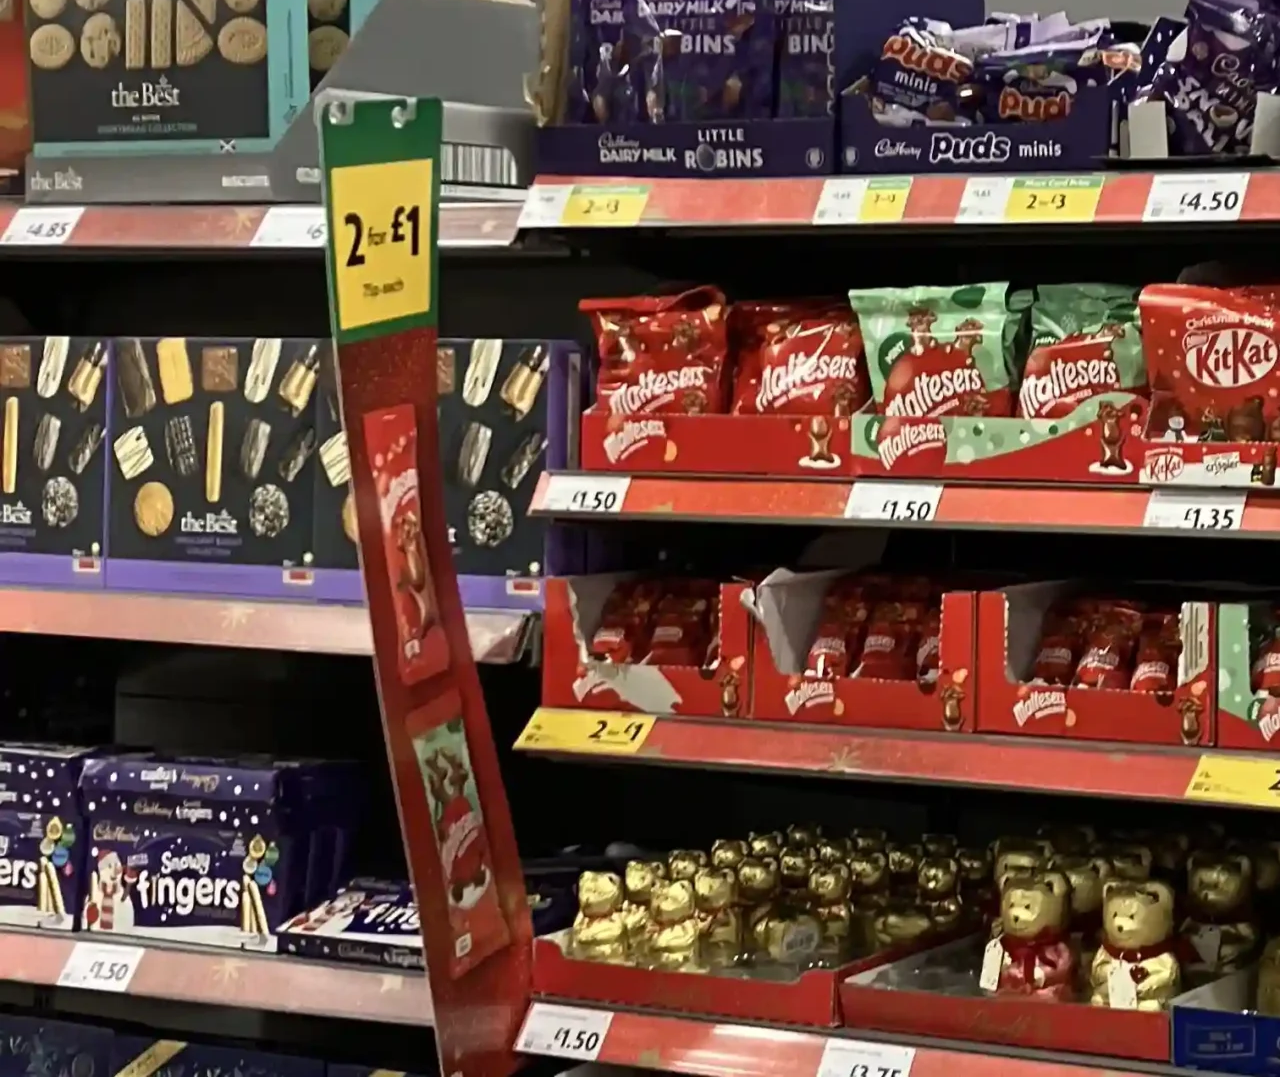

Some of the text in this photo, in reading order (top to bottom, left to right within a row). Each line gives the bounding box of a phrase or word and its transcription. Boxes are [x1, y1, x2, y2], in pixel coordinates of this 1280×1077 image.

[686, 0, 726, 14] MILK
[882, 35, 974, 82] Puds
[894, 70, 938, 93] minis
[111, 82, 180, 108] the Best
[599, 132, 641, 152] Cadbury
[698, 128, 745, 142] LITTLE
[600, 146, 678, 163] DAIRY MILK
[875, 131, 1062, 163] Cadbury Puds minis
[30, 169, 83, 190] the Best
[1026, 194, 1037, 209] 2
[1179, 191, 1239, 212] £4.50
[344, 205, 420, 267] 2 for £1
[884, 340, 906, 365] MINT
[1195, 328, 1274, 385] KitKat
[608, 364, 705, 416] Maltesers
[886, 367, 983, 417] Maltesers
[1019, 358, 1118, 421] Maltesers
[879, 423, 946, 471] Maltesers
[1148, 454, 1182, 482] KitKat
[572, 490, 617, 510] £1.50
[881, 500, 931, 521] £1.50
[3, 503, 32, 523] Best
[180, 511, 238, 533] the Best
[1184, 507, 1234, 530] £1.35
[1013, 690, 1067, 727] Maltesers
[588, 719, 606, 740] 2
[623, 720, 645, 742] £1
[161, 851, 211, 875] Snowy
[136, 869, 241, 916] fingers
[89, 960, 129, 981] £1.50
[554, 1025, 600, 1053] £1.50
